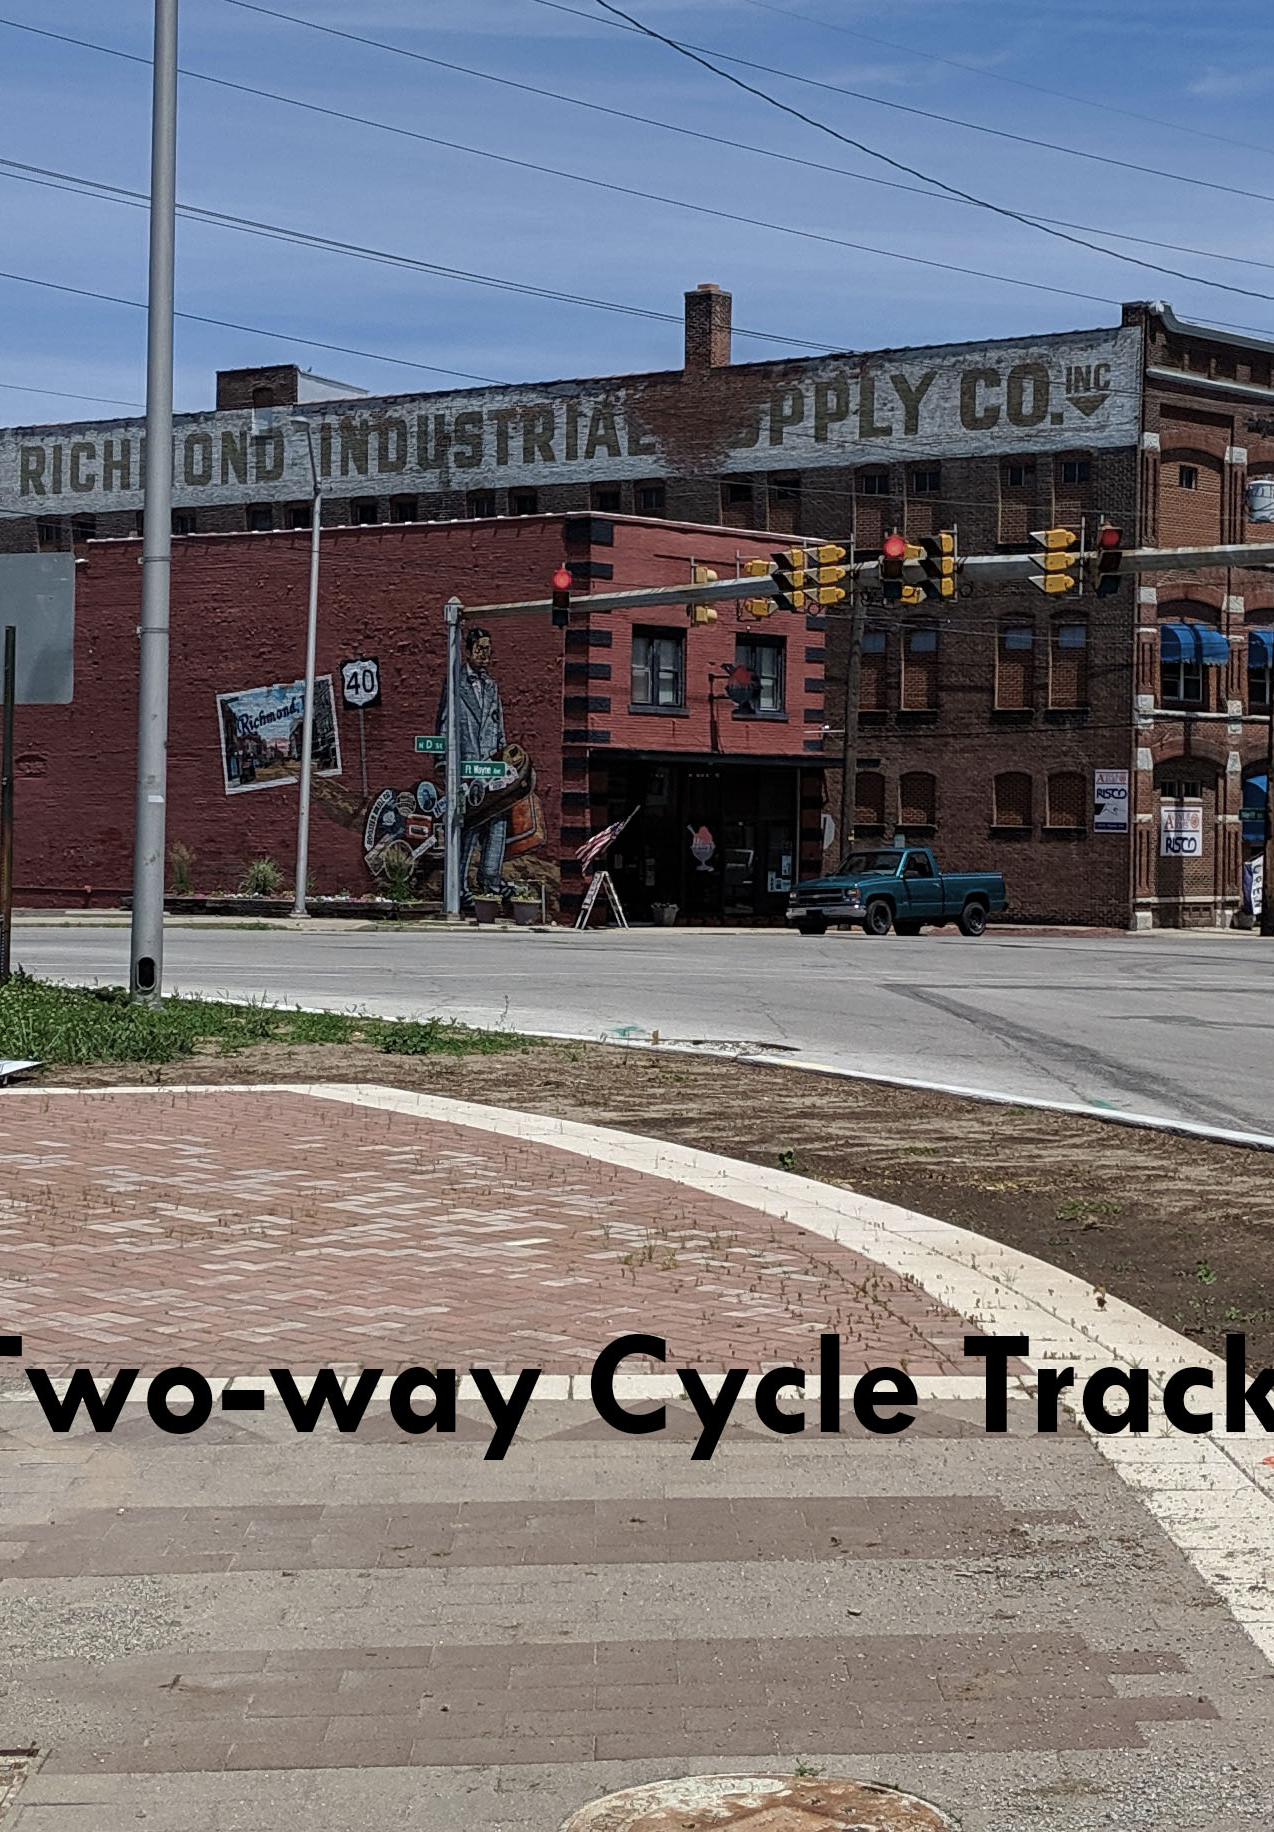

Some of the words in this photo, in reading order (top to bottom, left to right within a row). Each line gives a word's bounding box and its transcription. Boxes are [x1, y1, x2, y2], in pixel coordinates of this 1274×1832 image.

[319, 397, 657, 478] INDUSTRIAL
[724, 366, 937, 449] PPLY
[960, 362, 1064, 431] CO.
[1065, 363, 1112, 394] INC
[346, 669, 375, 695] 40
[426, 739, 433, 749] D
[465, 765, 471, 774] Ft
[474, 765, 491, 777] Wayne
[1096, 788, 1126, 799] RISCO
[1165, 837, 1196, 853] RISCO
